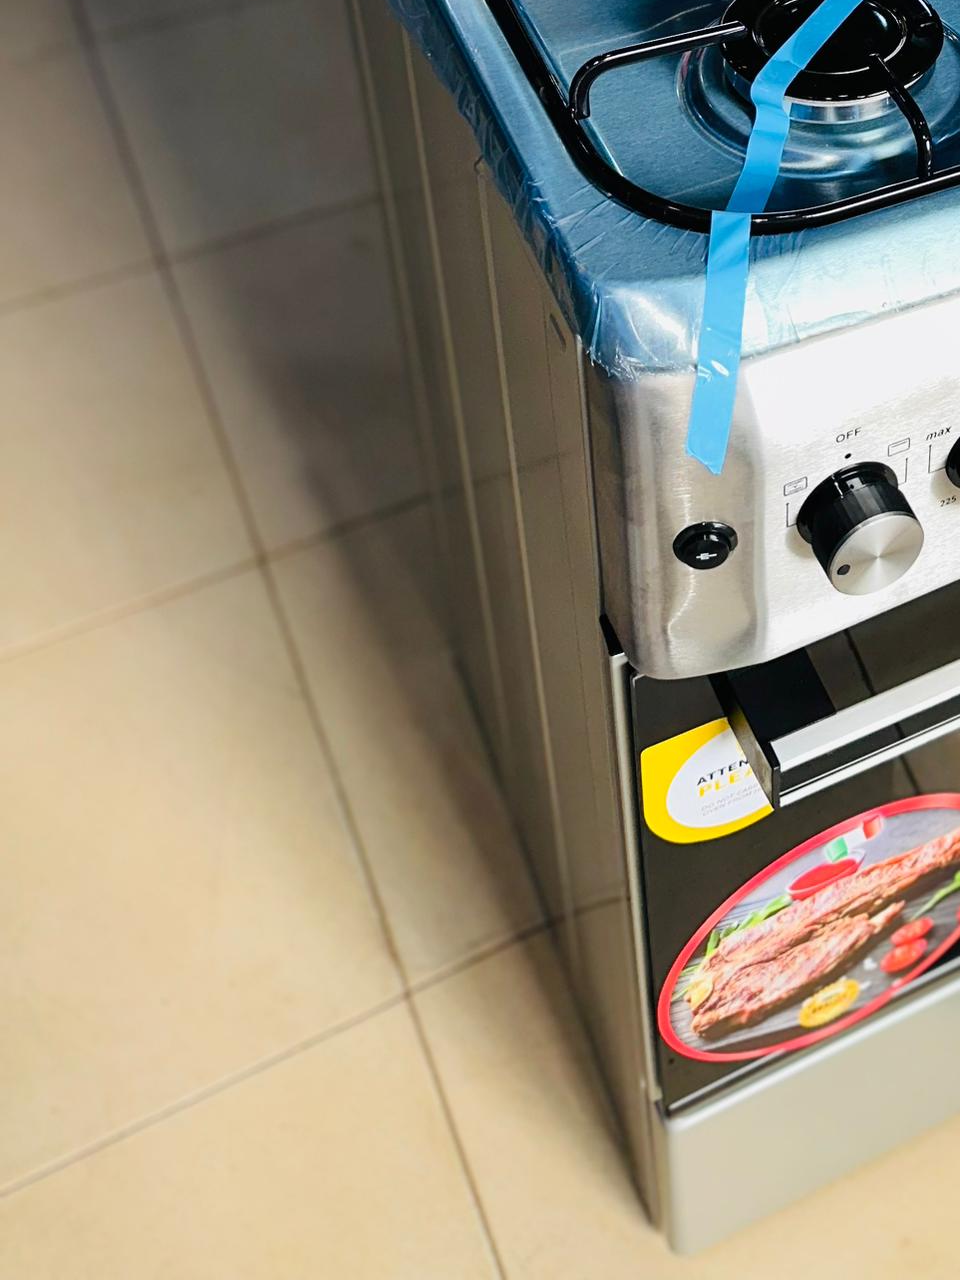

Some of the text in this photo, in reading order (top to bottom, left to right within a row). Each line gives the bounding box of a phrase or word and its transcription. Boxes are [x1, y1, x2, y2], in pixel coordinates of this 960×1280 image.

[836, 427, 862, 443] OFF
[926, 426, 951, 441] max
[940, 495, 957, 507] 225
[697, 759, 749, 786] ATTEN
